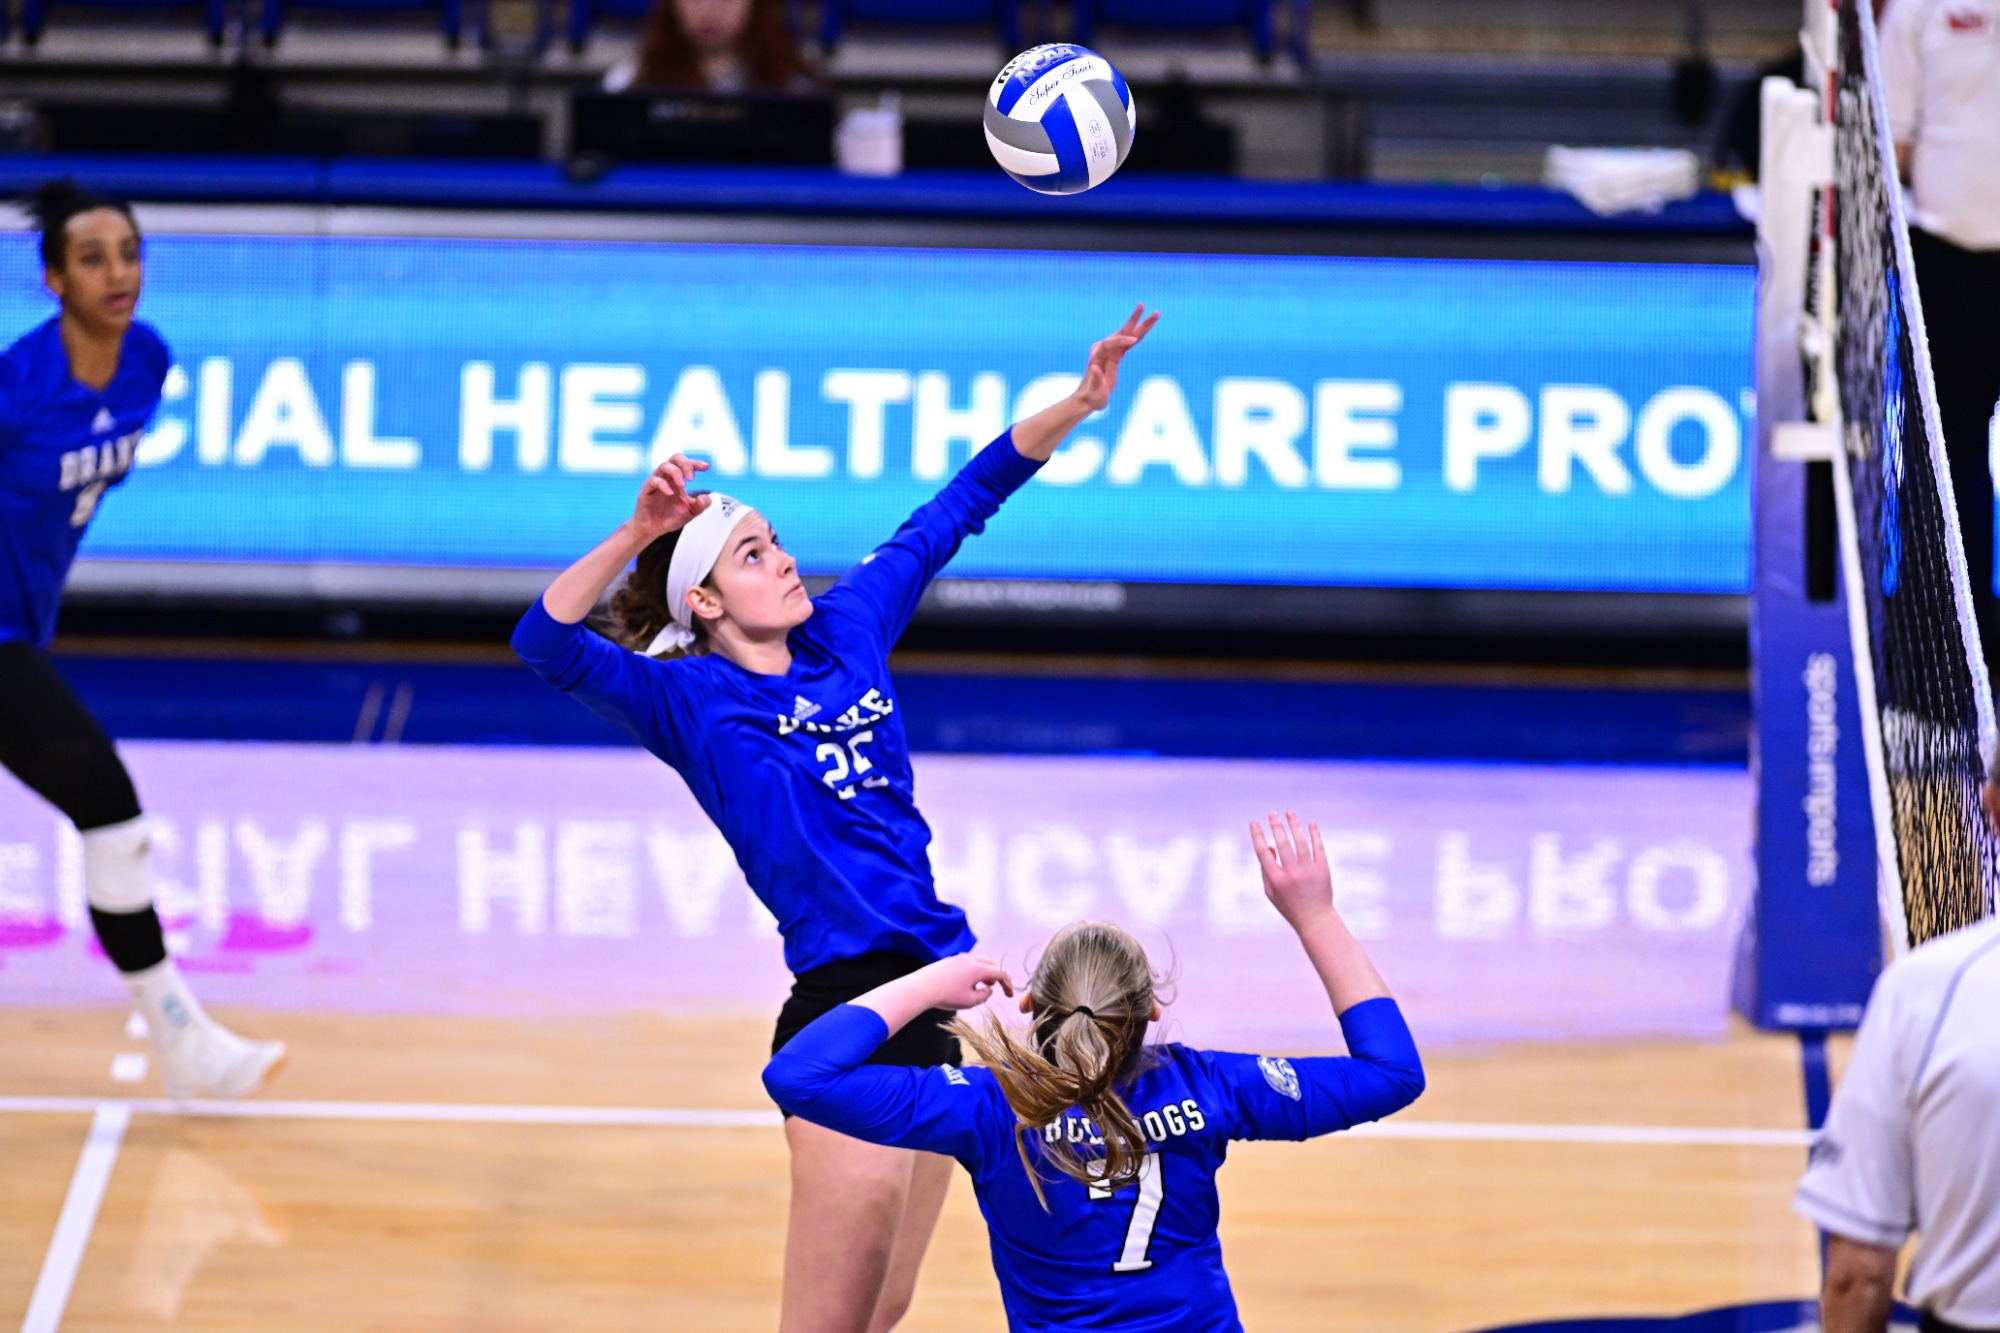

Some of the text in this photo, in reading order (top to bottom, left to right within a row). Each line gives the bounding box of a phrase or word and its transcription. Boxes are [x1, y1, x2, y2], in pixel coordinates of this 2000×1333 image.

[1014, 45, 1077, 84] NCAA
[1029, 79, 1060, 106] Super
[1062, 61, 1095, 81] Touch
[457, 360, 1403, 491] HEALTHCARE
[1087, 1153, 1163, 1272] 7
